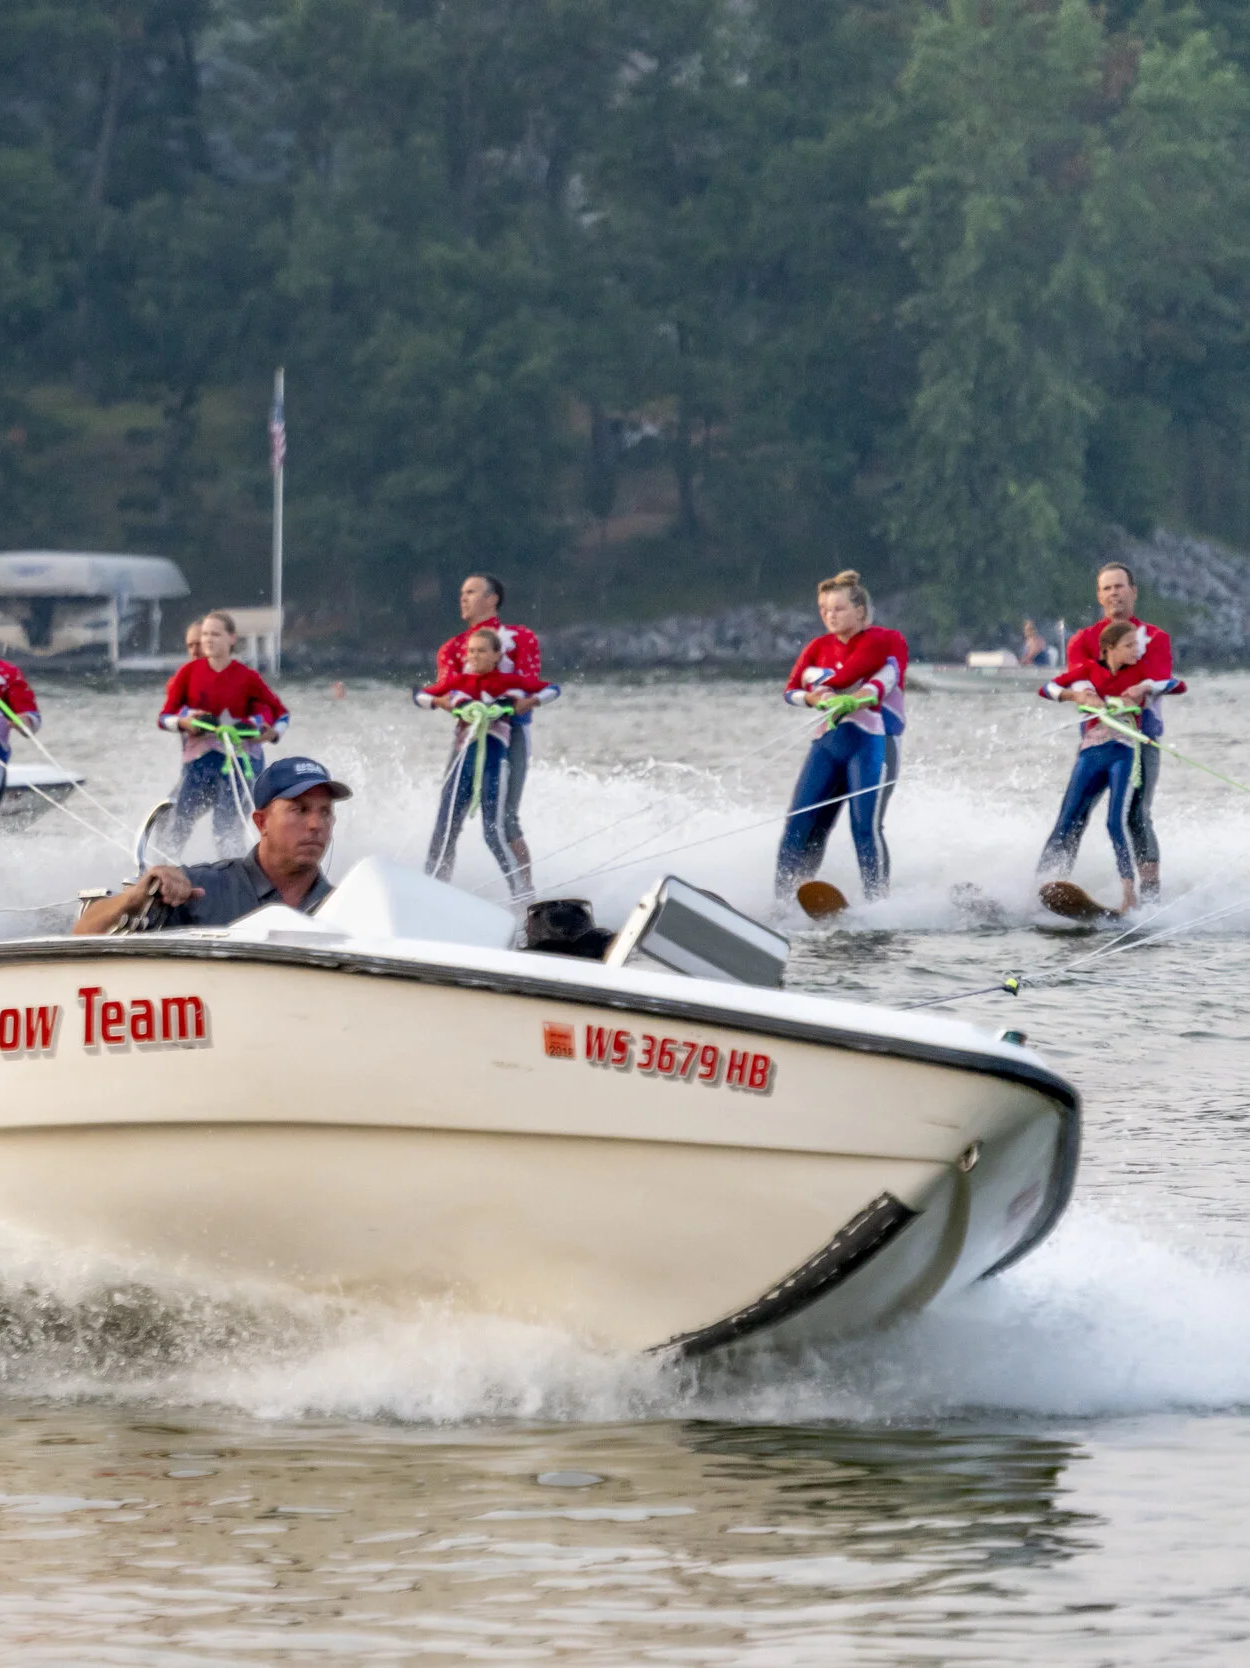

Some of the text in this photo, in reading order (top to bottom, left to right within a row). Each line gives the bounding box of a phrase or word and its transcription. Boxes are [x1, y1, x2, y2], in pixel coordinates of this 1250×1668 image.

[77, 986, 206, 1047] Team
[584, 1024, 772, 1091] WS 3679 HB
